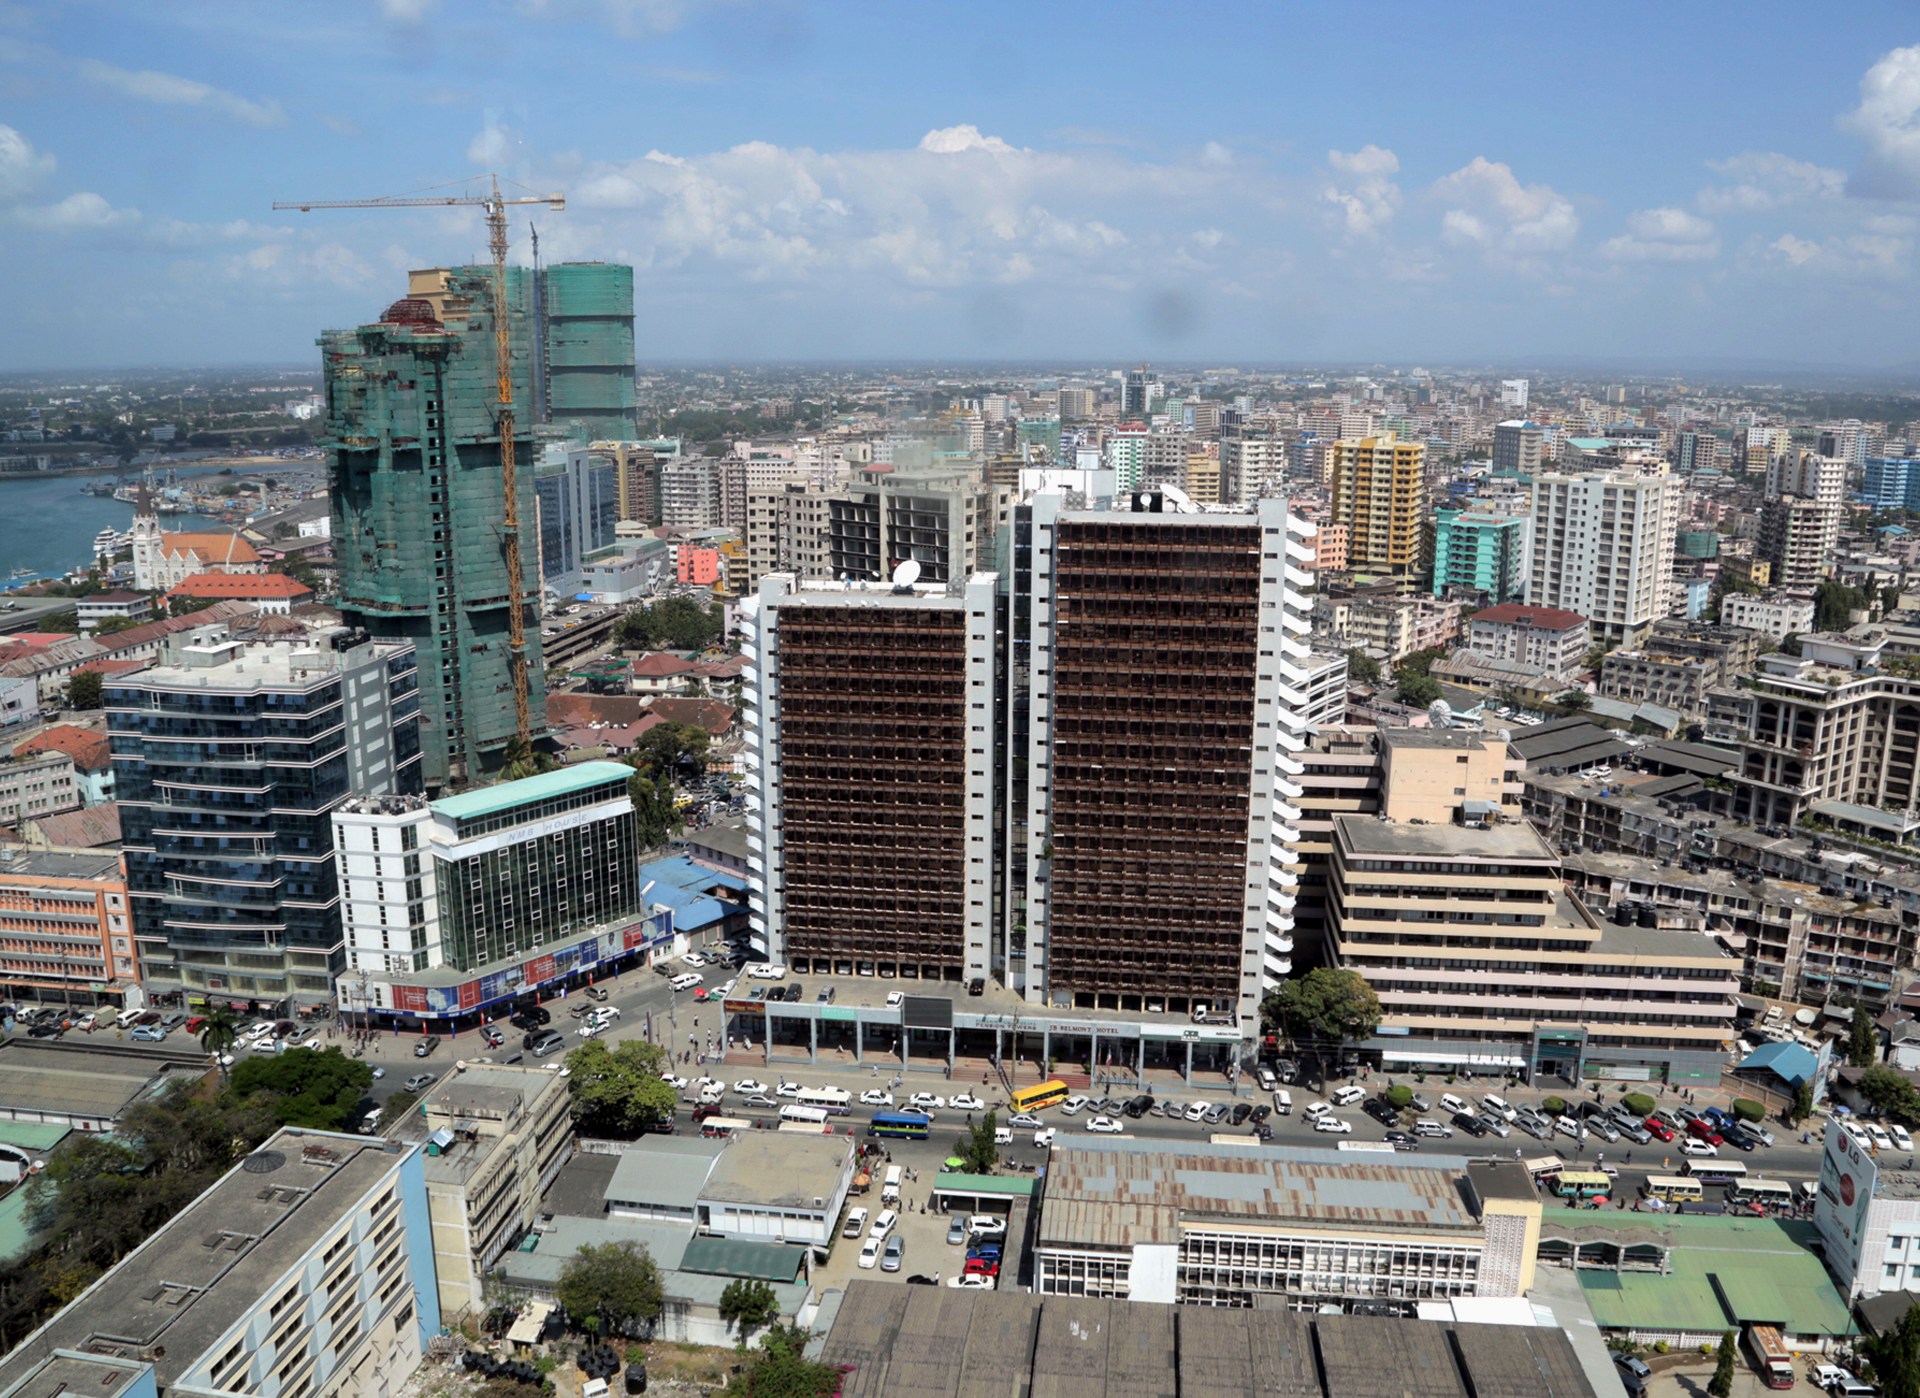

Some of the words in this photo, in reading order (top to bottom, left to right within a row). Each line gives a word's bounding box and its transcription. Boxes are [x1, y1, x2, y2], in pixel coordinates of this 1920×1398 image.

[508, 828, 534, 841] NMB
[545, 815, 588, 831] HOUSE
[1848, 1146, 1859, 1165] LG
